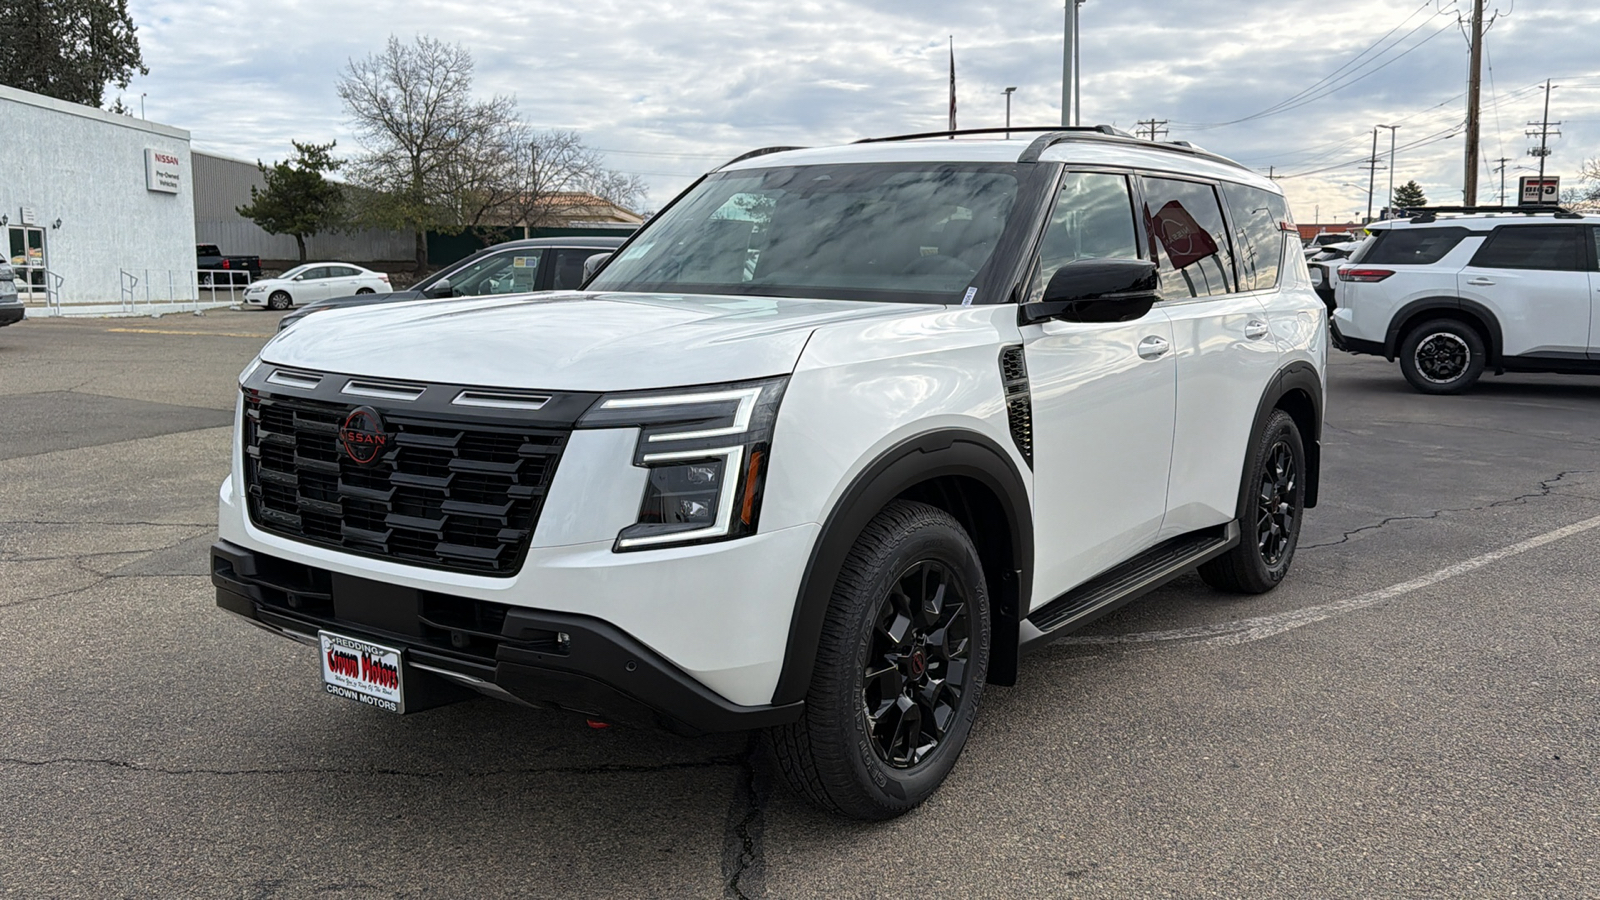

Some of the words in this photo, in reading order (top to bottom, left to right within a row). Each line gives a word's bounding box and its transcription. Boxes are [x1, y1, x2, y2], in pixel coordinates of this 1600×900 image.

[155, 153, 178, 165] NISSAN
[156, 170, 179, 180] Pre-Owned
[336, 637, 379, 655] REDDING
[327, 648, 359, 679] Crown
[361, 651, 398, 690] Motors
[326, 684, 359, 701] CROWN
[359, 693, 397, 712] MOTORS
